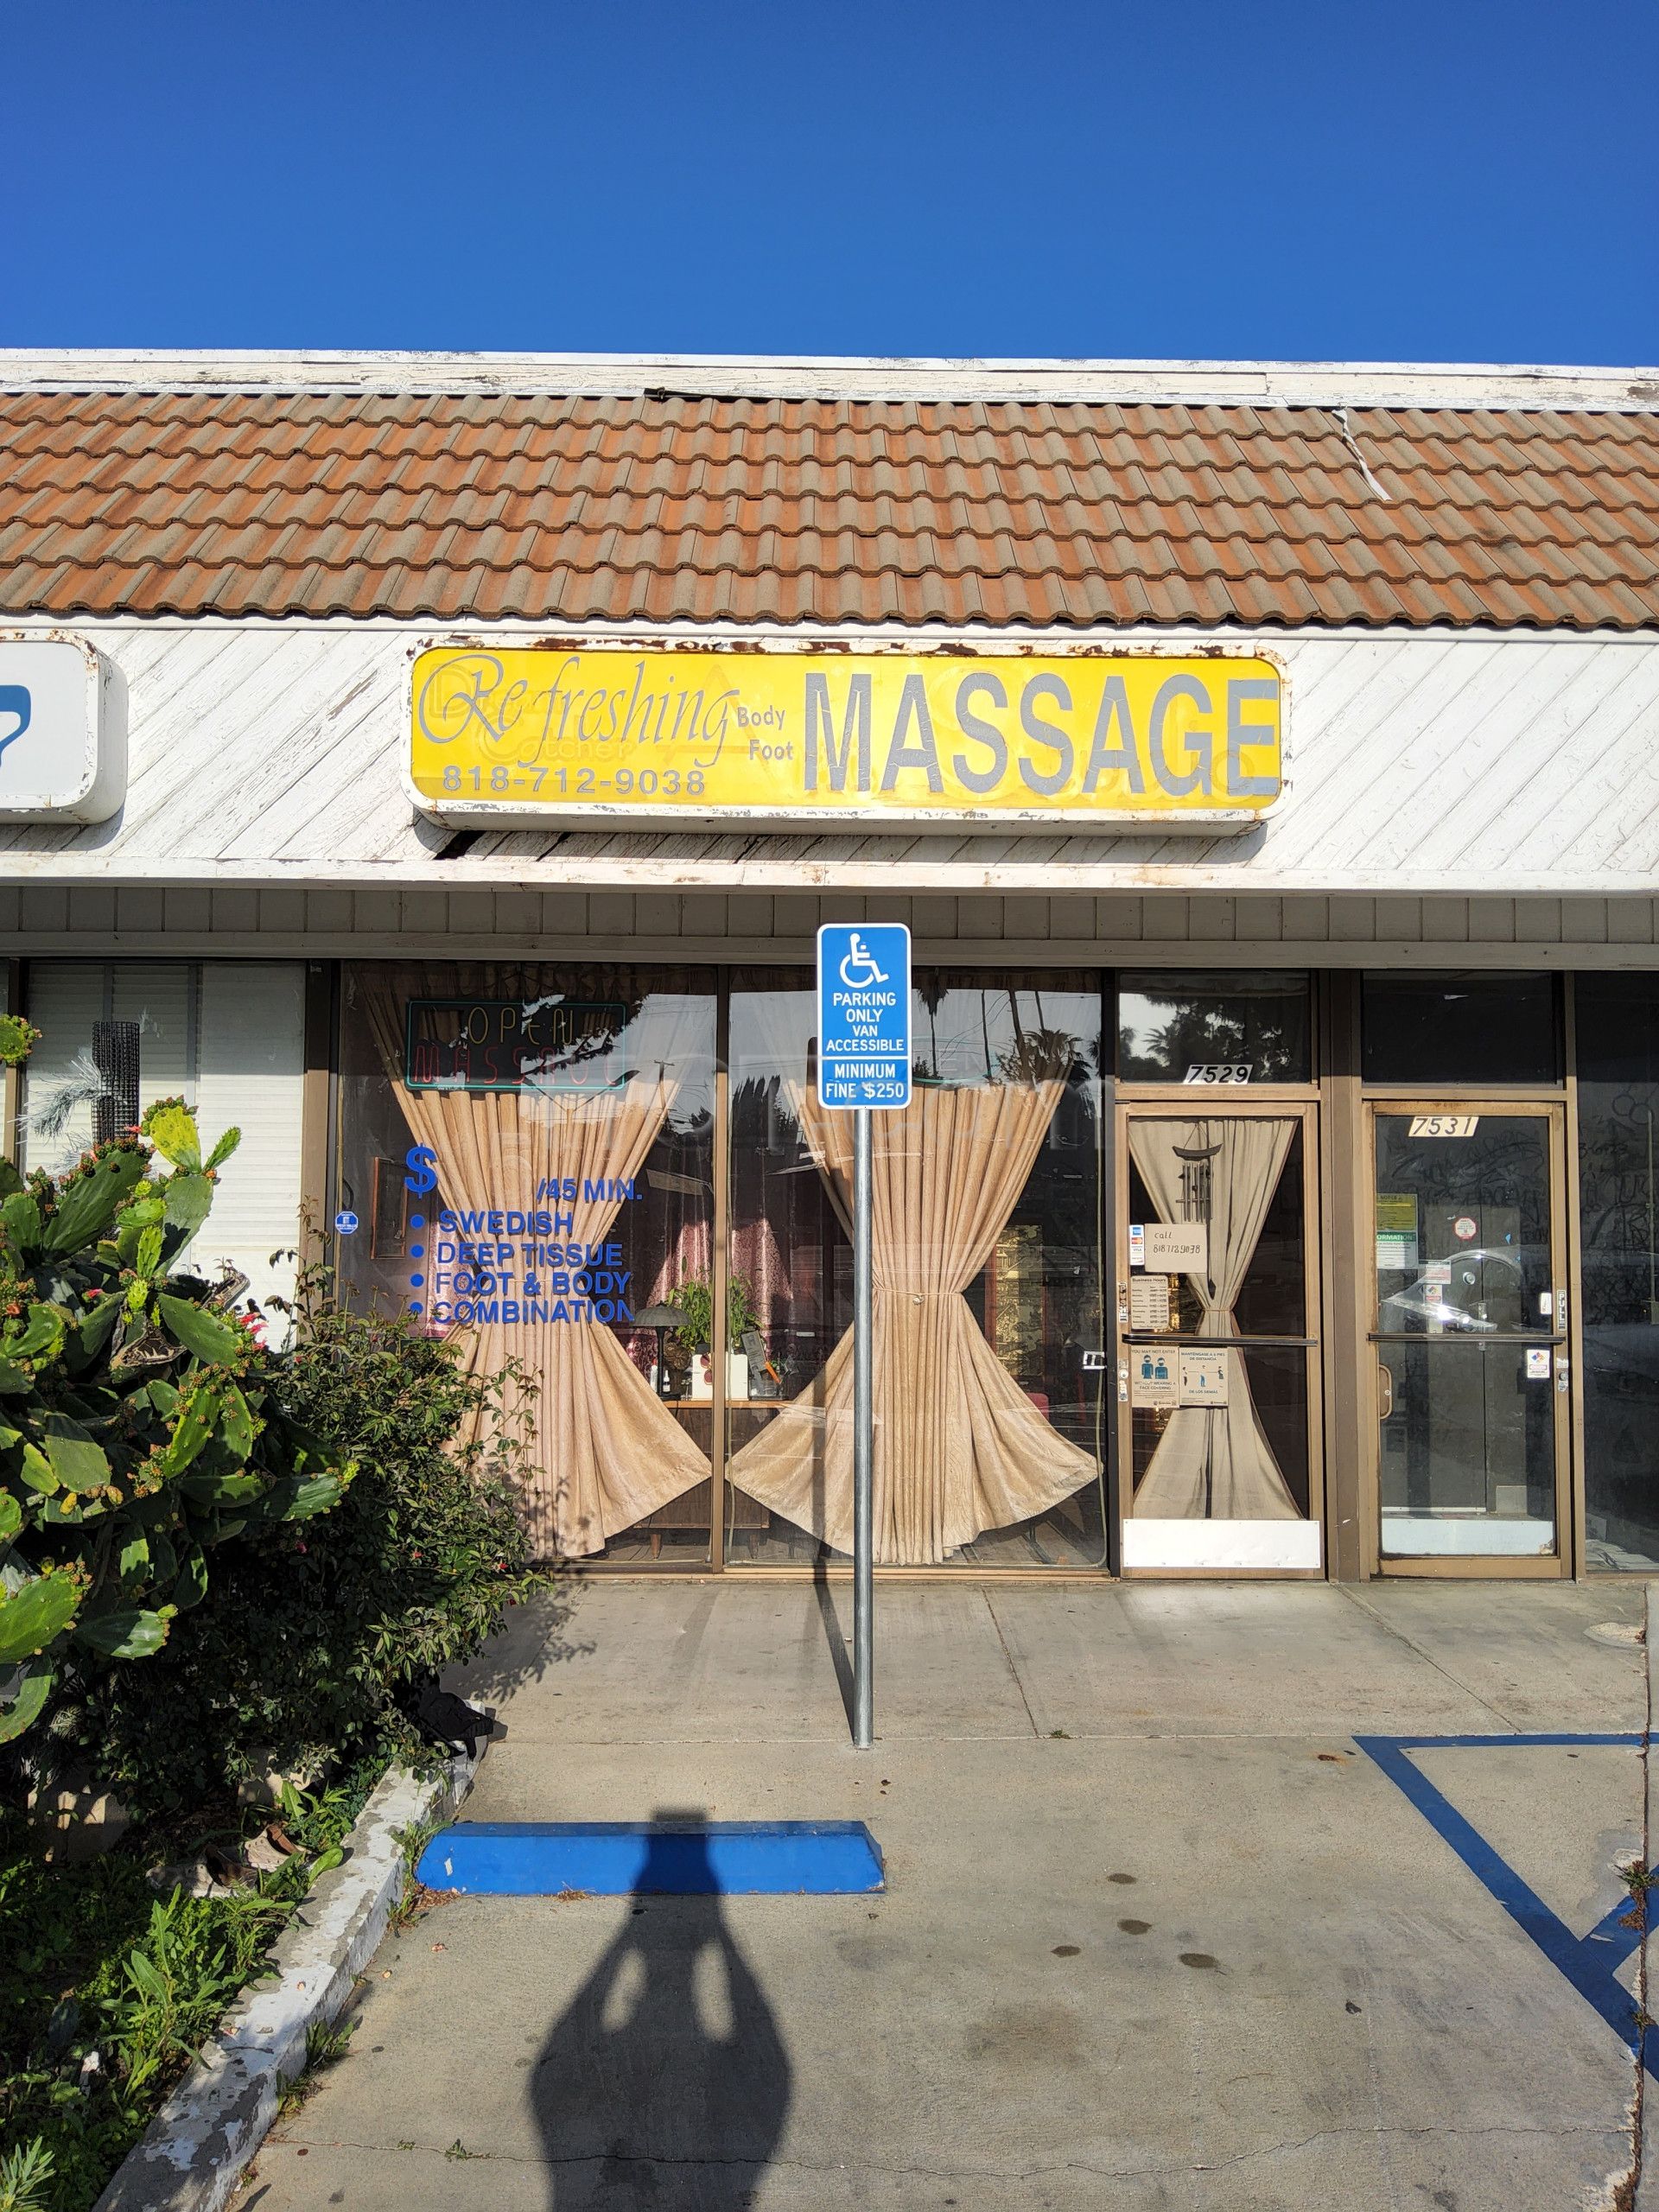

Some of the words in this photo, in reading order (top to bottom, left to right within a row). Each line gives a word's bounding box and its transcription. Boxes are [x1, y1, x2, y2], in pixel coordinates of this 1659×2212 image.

[738, 706, 785, 731] Body
[804, 672, 1279, 797] MASSAGE
[750, 739, 793, 760] Foot
[442, 766, 706, 796] 818-712-9038
[833, 992, 897, 1007] PARKING
[467, 1007, 574, 1046] OPEN
[846, 1009, 883, 1023] ONLY
[852, 1025, 878, 1037] VAN
[826, 1039, 905, 1052] ACCESSIBLE
[835, 1064, 896, 1078] MINIMUM
[1188, 1065, 1249, 1084] 7529
[826, 1084, 856, 1098] FINE
[864, 1083, 905, 1099] $250
[1413, 1117, 1472, 1135] 7531
[404, 1142, 438, 1199] $
[583, 1178, 644, 1202] MIN.
[438, 1211, 574, 1236] SWEDISH
[437, 1242, 515, 1267] DEEP
[520, 1243, 624, 1268] TISSUE
[435, 1271, 511, 1296] FOOT
[523, 1273, 542, 1295] &
[552, 1271, 632, 1296] BODY
[433, 1299, 635, 1325] COMBINATION
